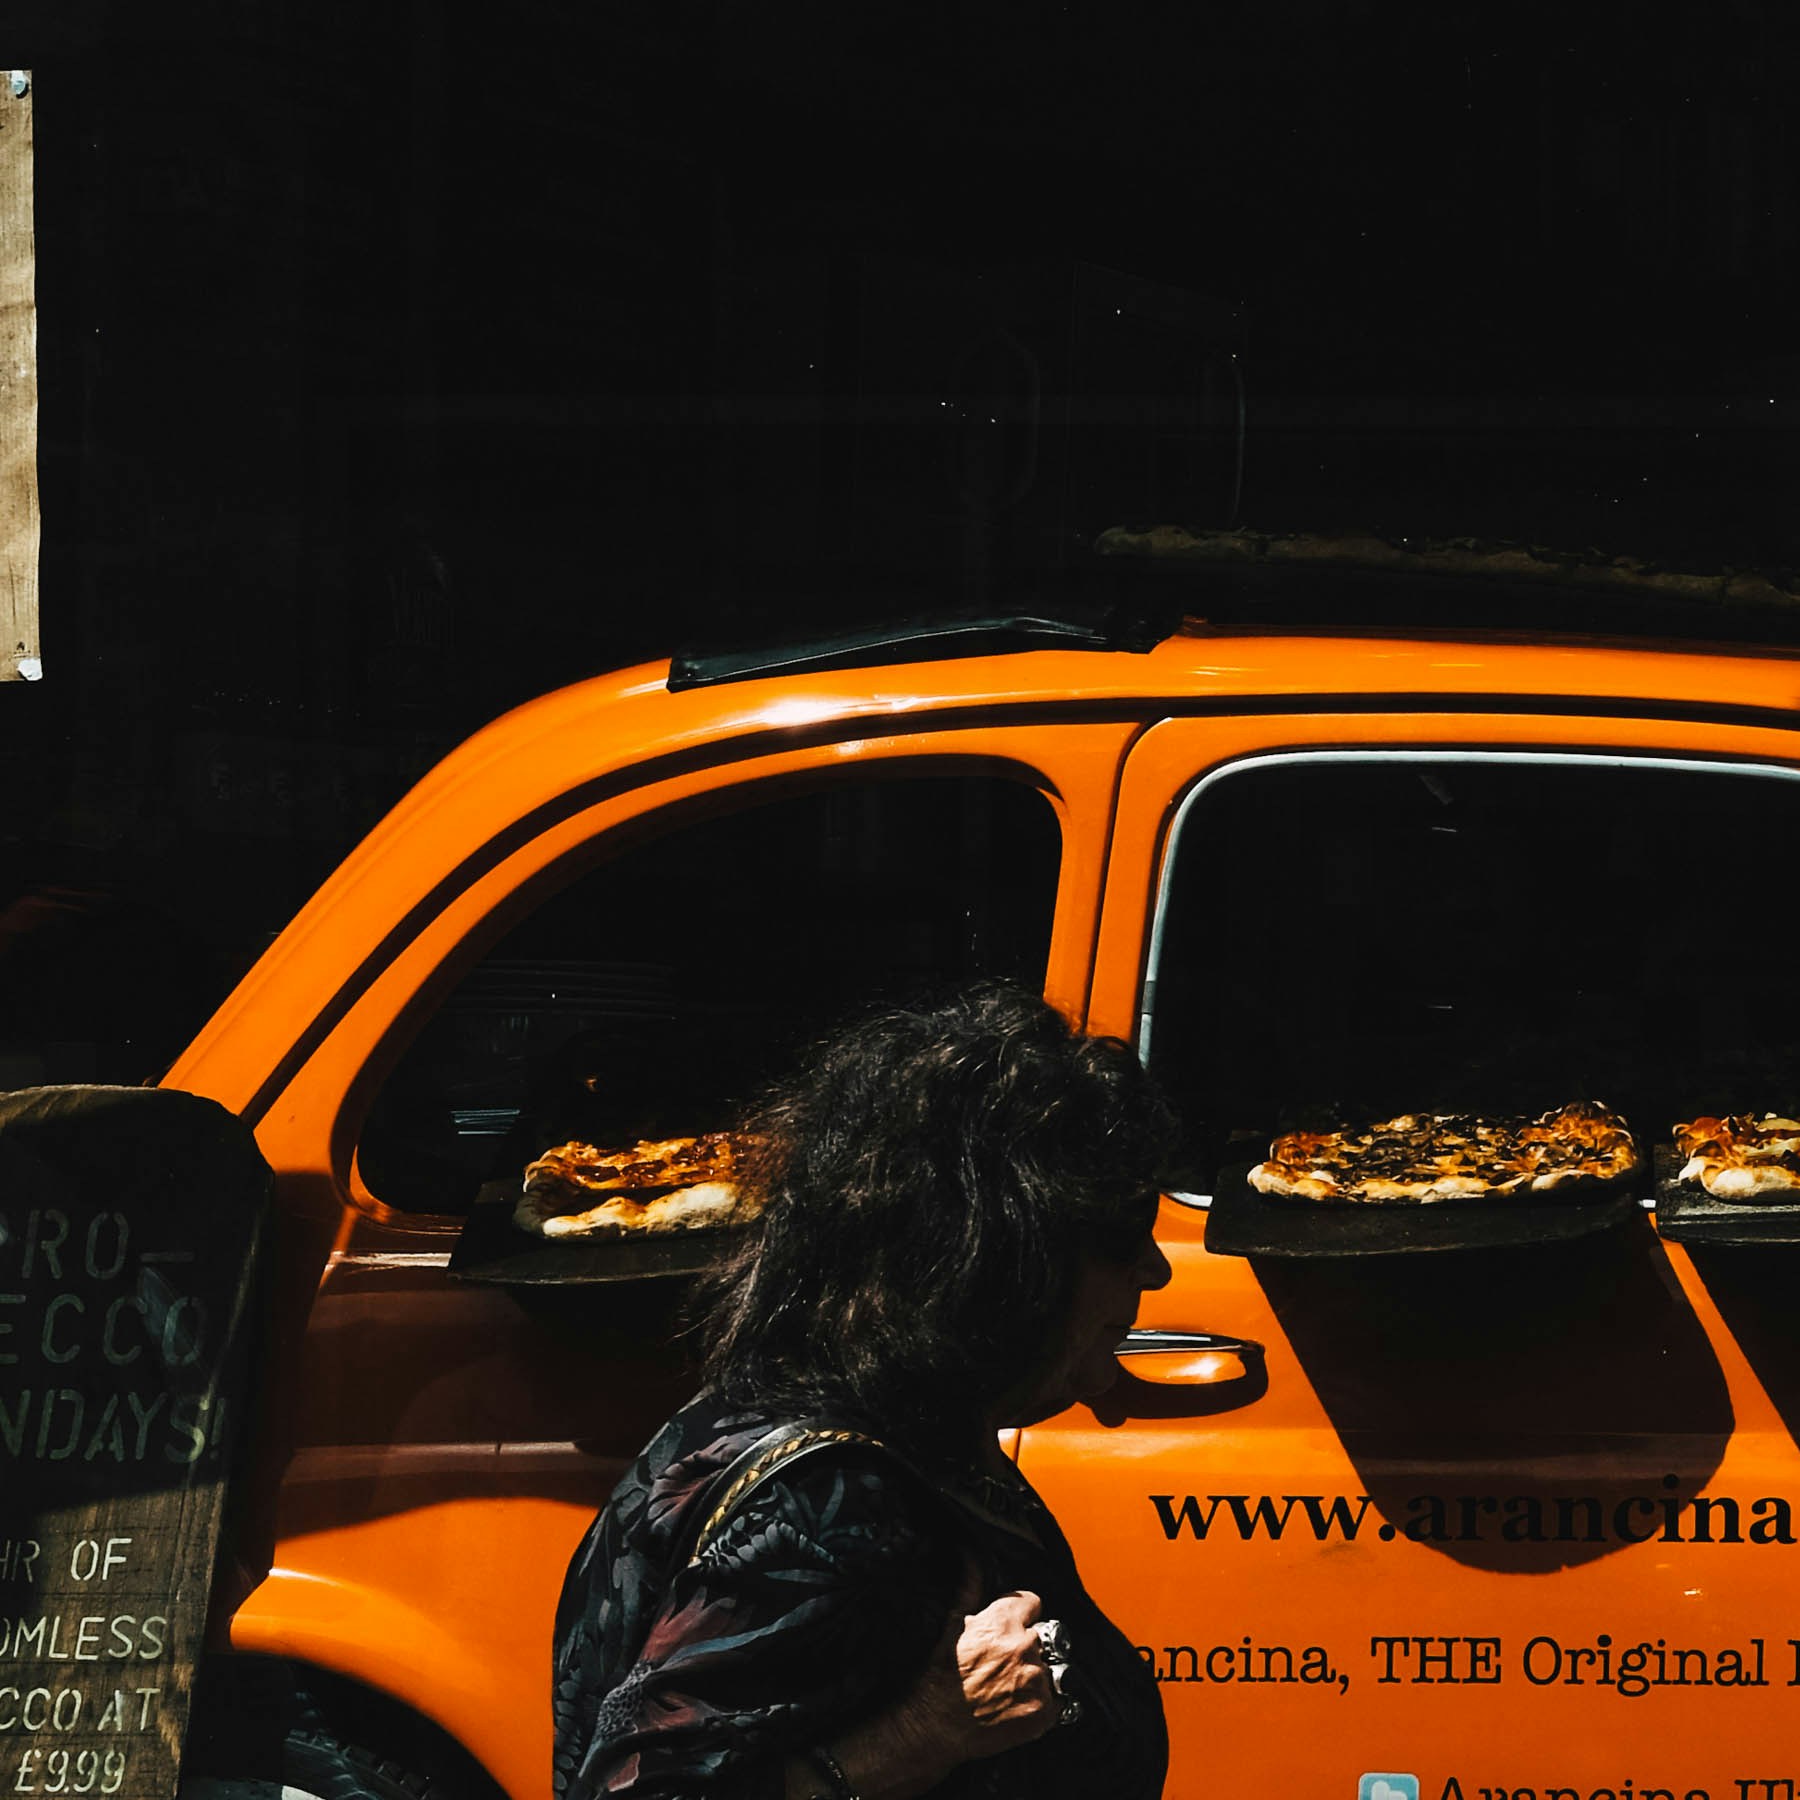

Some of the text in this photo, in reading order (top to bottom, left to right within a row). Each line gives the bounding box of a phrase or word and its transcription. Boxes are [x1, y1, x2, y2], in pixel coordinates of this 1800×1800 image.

[70, 1537, 133, 1582] OF
[1371, 1637, 1502, 1684] THE
[1522, 1635, 1770, 1697] Original
[14, 1747, 127, 1794] £9.99
